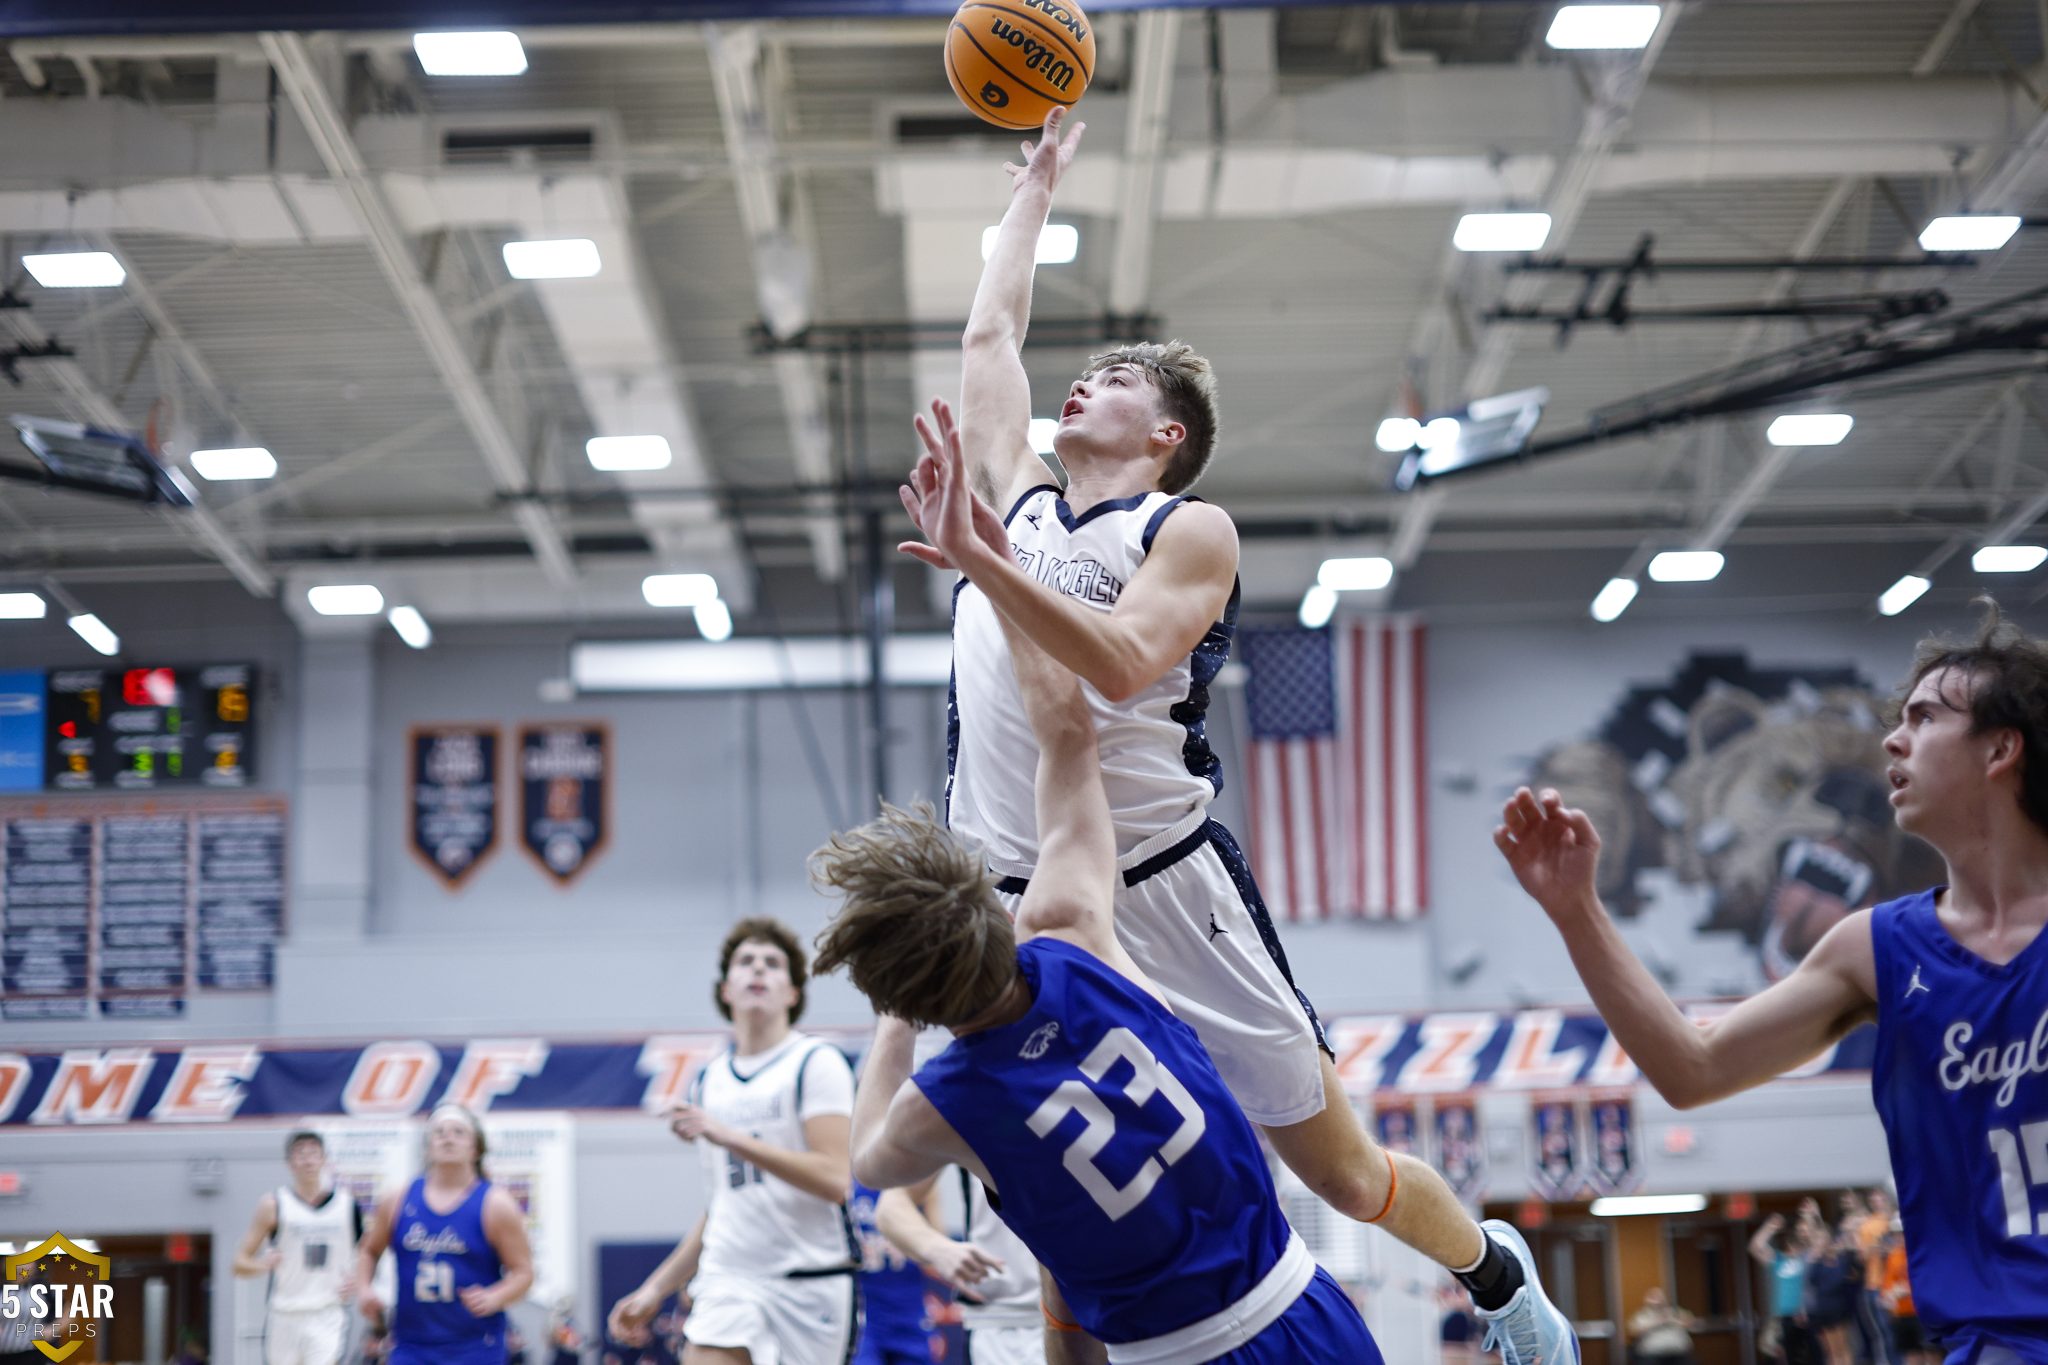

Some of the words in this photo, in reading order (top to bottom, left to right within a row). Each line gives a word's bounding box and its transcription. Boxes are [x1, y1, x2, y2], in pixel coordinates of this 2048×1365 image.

[990, 17, 1075, 92] Wilson
[340, 1037, 552, 1119] OF
[1025, 1027, 1206, 1222] 23
